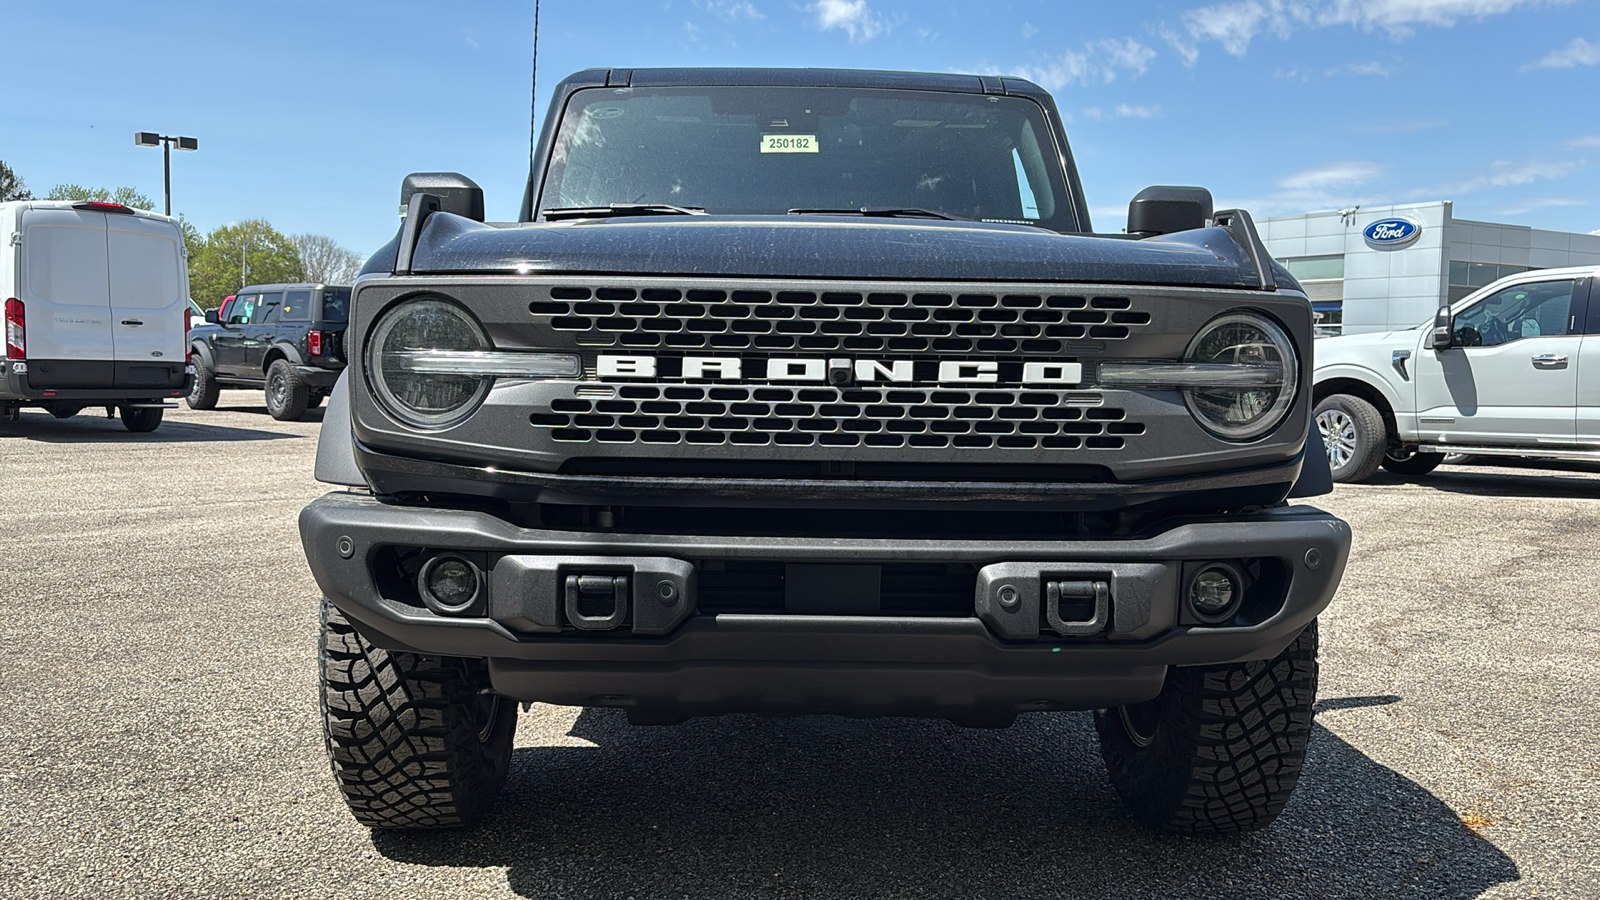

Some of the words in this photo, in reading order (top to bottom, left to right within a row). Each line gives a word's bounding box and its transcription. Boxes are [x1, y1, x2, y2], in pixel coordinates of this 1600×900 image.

[768, 138, 810, 149] 250182
[1373, 223, 1405, 239] Ford
[596, 354, 1083, 385] BRONCO
